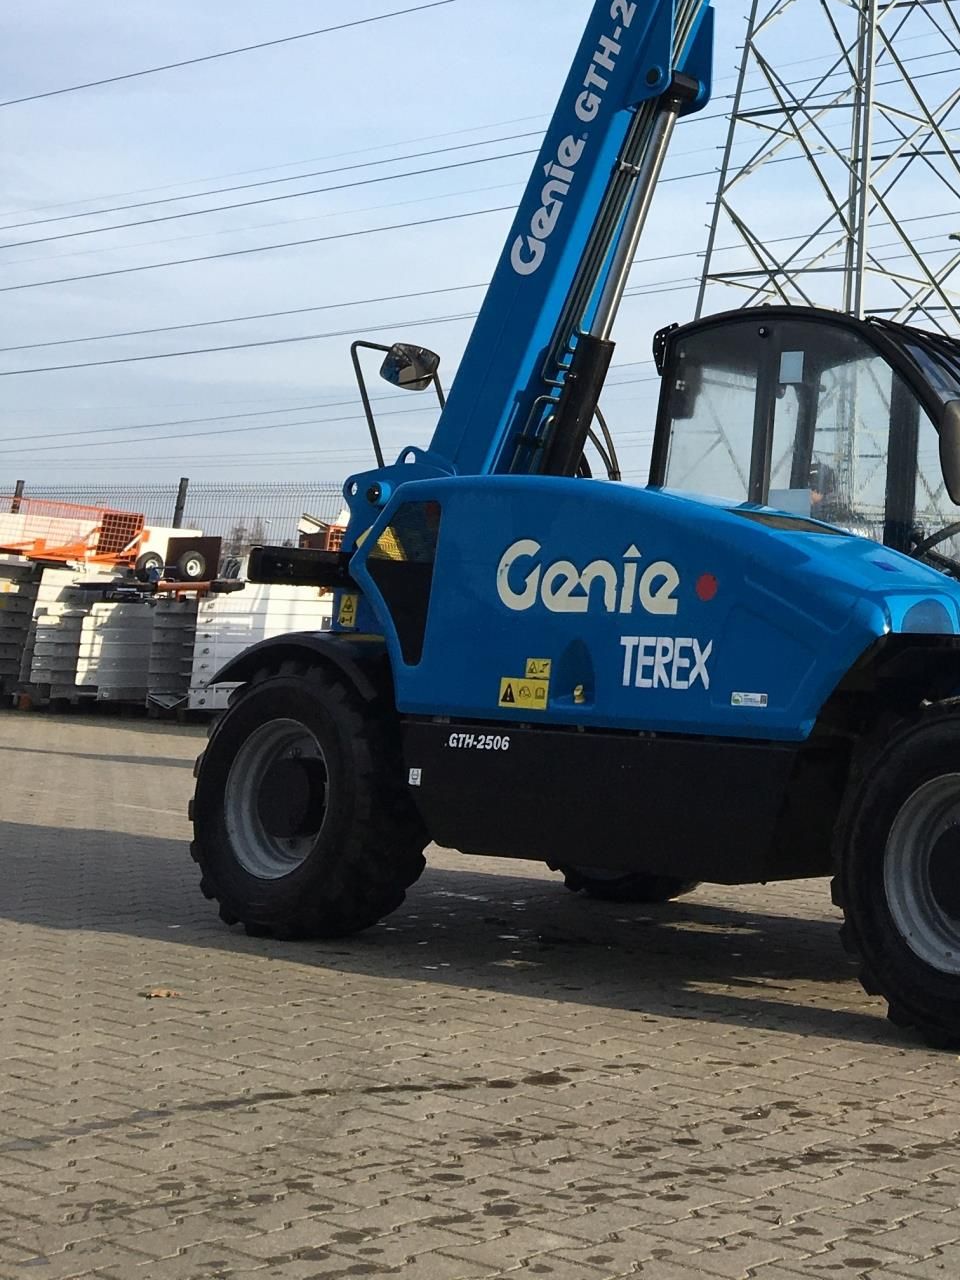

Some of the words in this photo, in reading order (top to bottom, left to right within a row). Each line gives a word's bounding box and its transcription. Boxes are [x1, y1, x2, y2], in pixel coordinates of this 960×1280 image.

[510, 135, 586, 275] Genie
[496, 538, 680, 615] Genie
[620, 635, 713, 690] TEREX
[448, 733, 510, 751] GTH-2506
